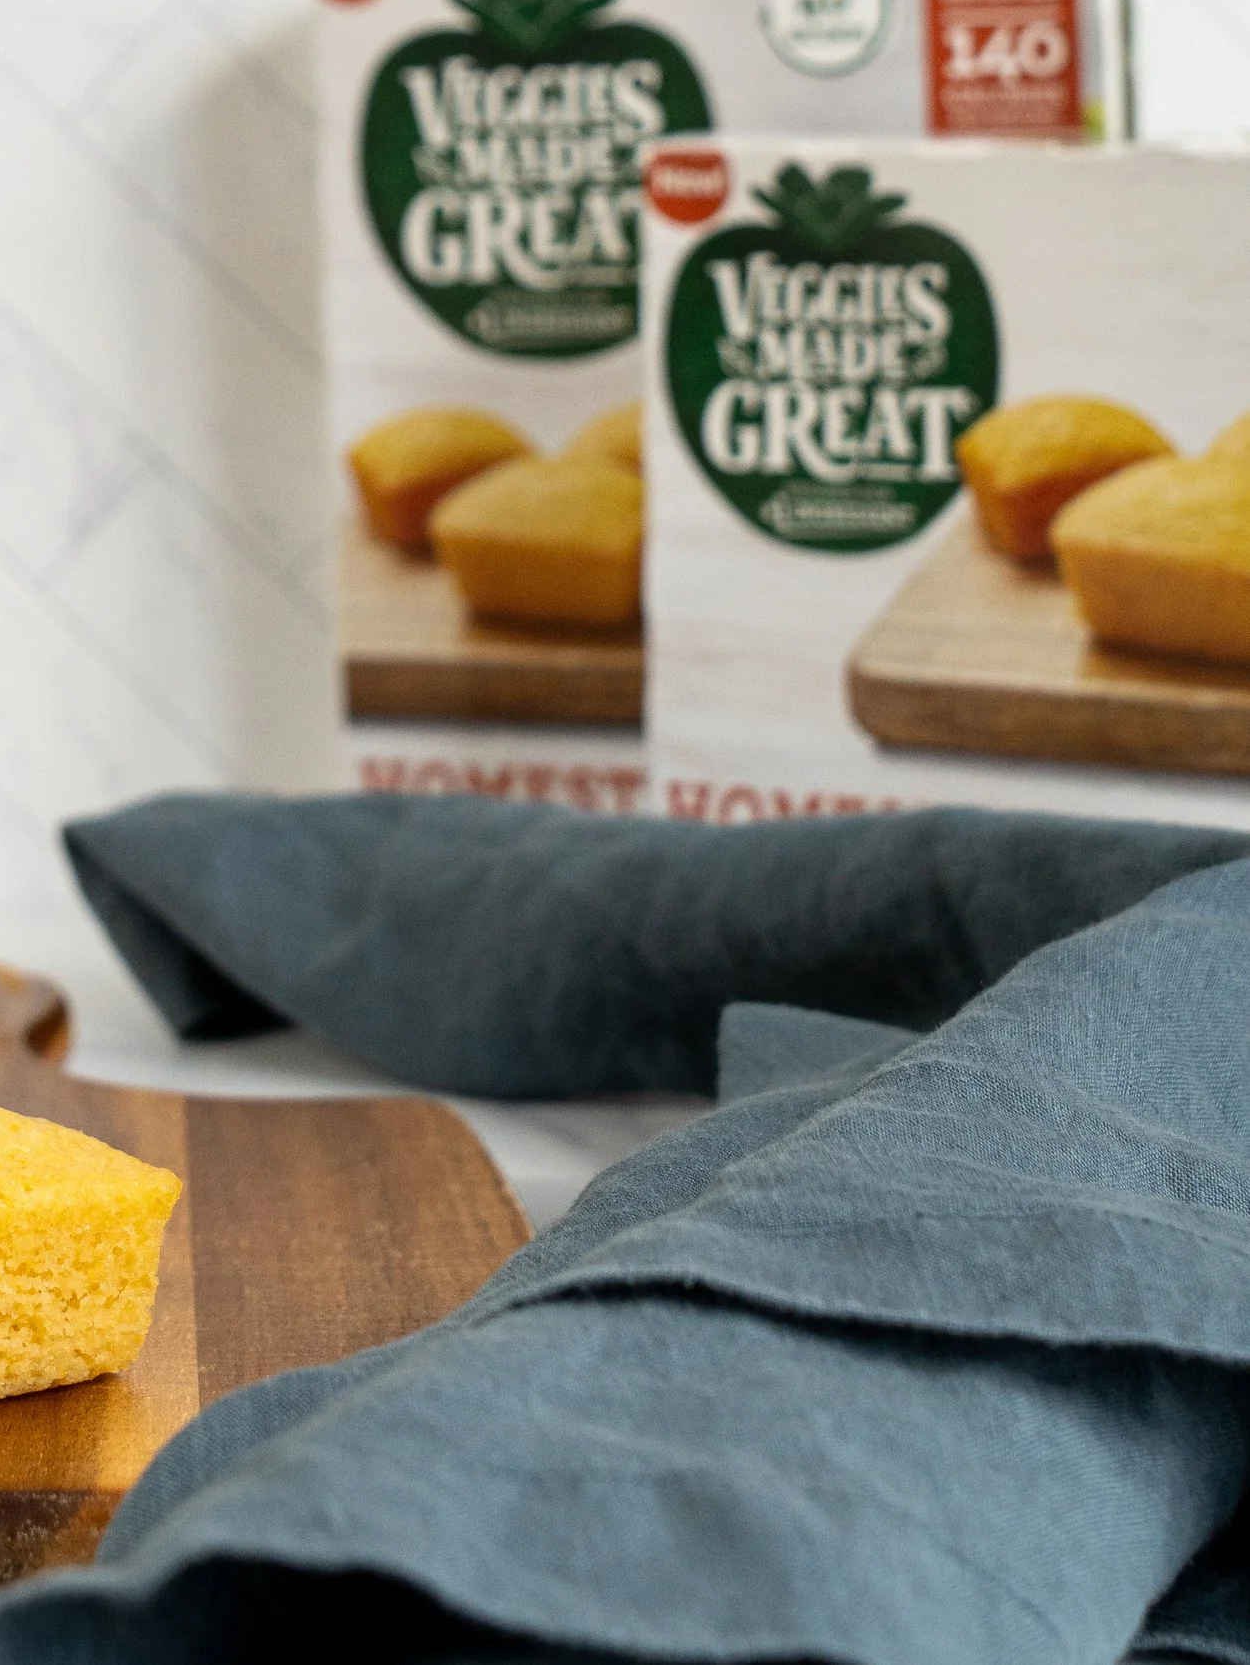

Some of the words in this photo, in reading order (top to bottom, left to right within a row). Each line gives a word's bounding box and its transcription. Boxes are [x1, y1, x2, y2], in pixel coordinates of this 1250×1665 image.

[943, 20, 1069, 87] 140
[399, 55, 666, 147] VEGGIES
[458, 135, 612, 185] MADE
[704, 251, 953, 341] VEGGIES
[754, 329, 906, 382] MADE
[701, 377, 981, 484] GREAT
